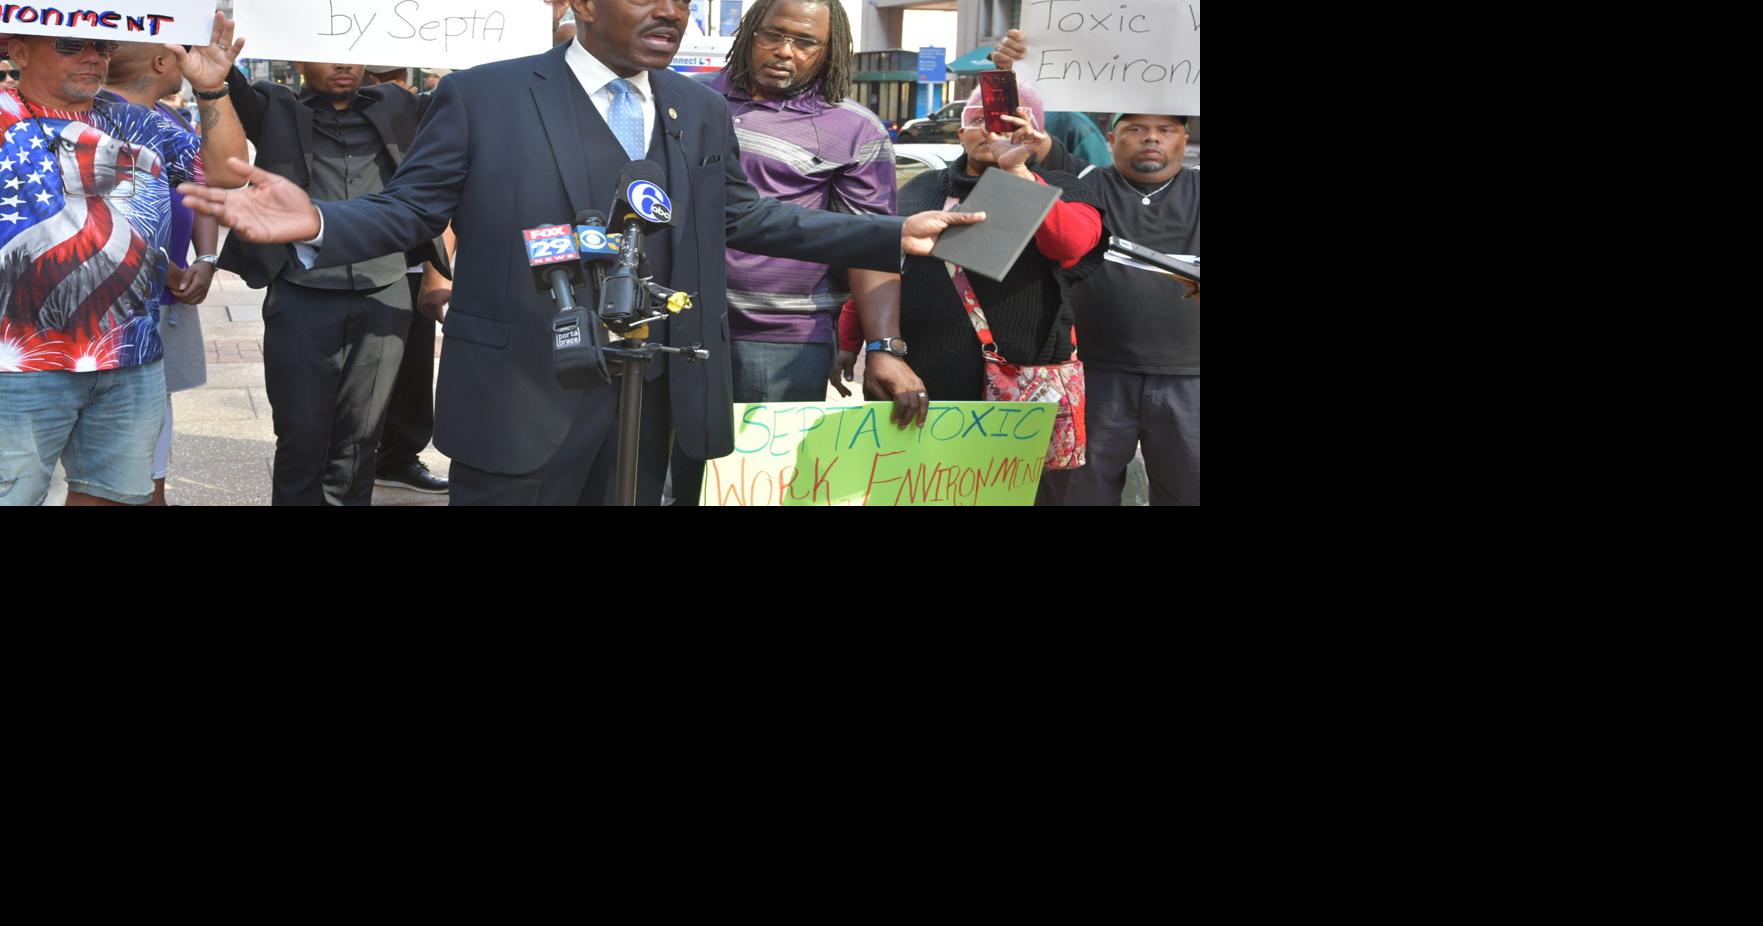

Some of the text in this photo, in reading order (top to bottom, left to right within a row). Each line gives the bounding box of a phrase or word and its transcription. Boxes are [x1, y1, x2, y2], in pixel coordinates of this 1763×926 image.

[0, 4, 174, 36] ronmeNT
[317, 0, 377, 51] by
[1031, 0, 1150, 33] Toxic
[1036, 49, 1200, 84] Environ
[651, 206, 671, 219] abc
[530, 227, 564, 240] FOX
[531, 238, 573, 257] 29
[534, 253, 576, 263] NEWS
[735, 405, 881, 457] SEPTA
[712, 456, 831, 507] WORK
